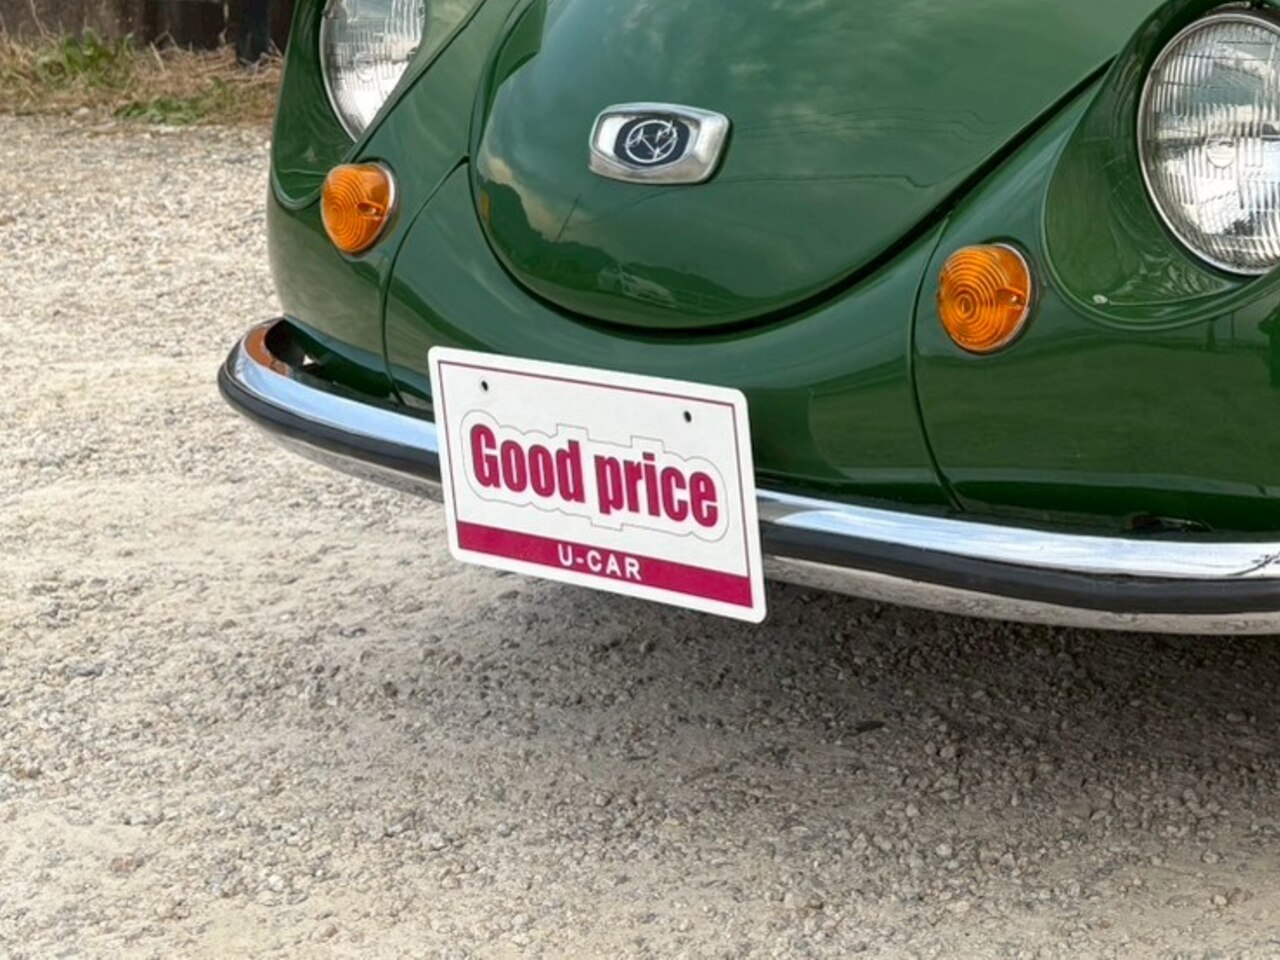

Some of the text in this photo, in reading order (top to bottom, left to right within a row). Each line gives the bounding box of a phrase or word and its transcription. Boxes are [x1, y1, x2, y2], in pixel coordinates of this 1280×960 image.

[470, 423, 720, 528] Good price
[557, 543, 642, 581] U-CAR
